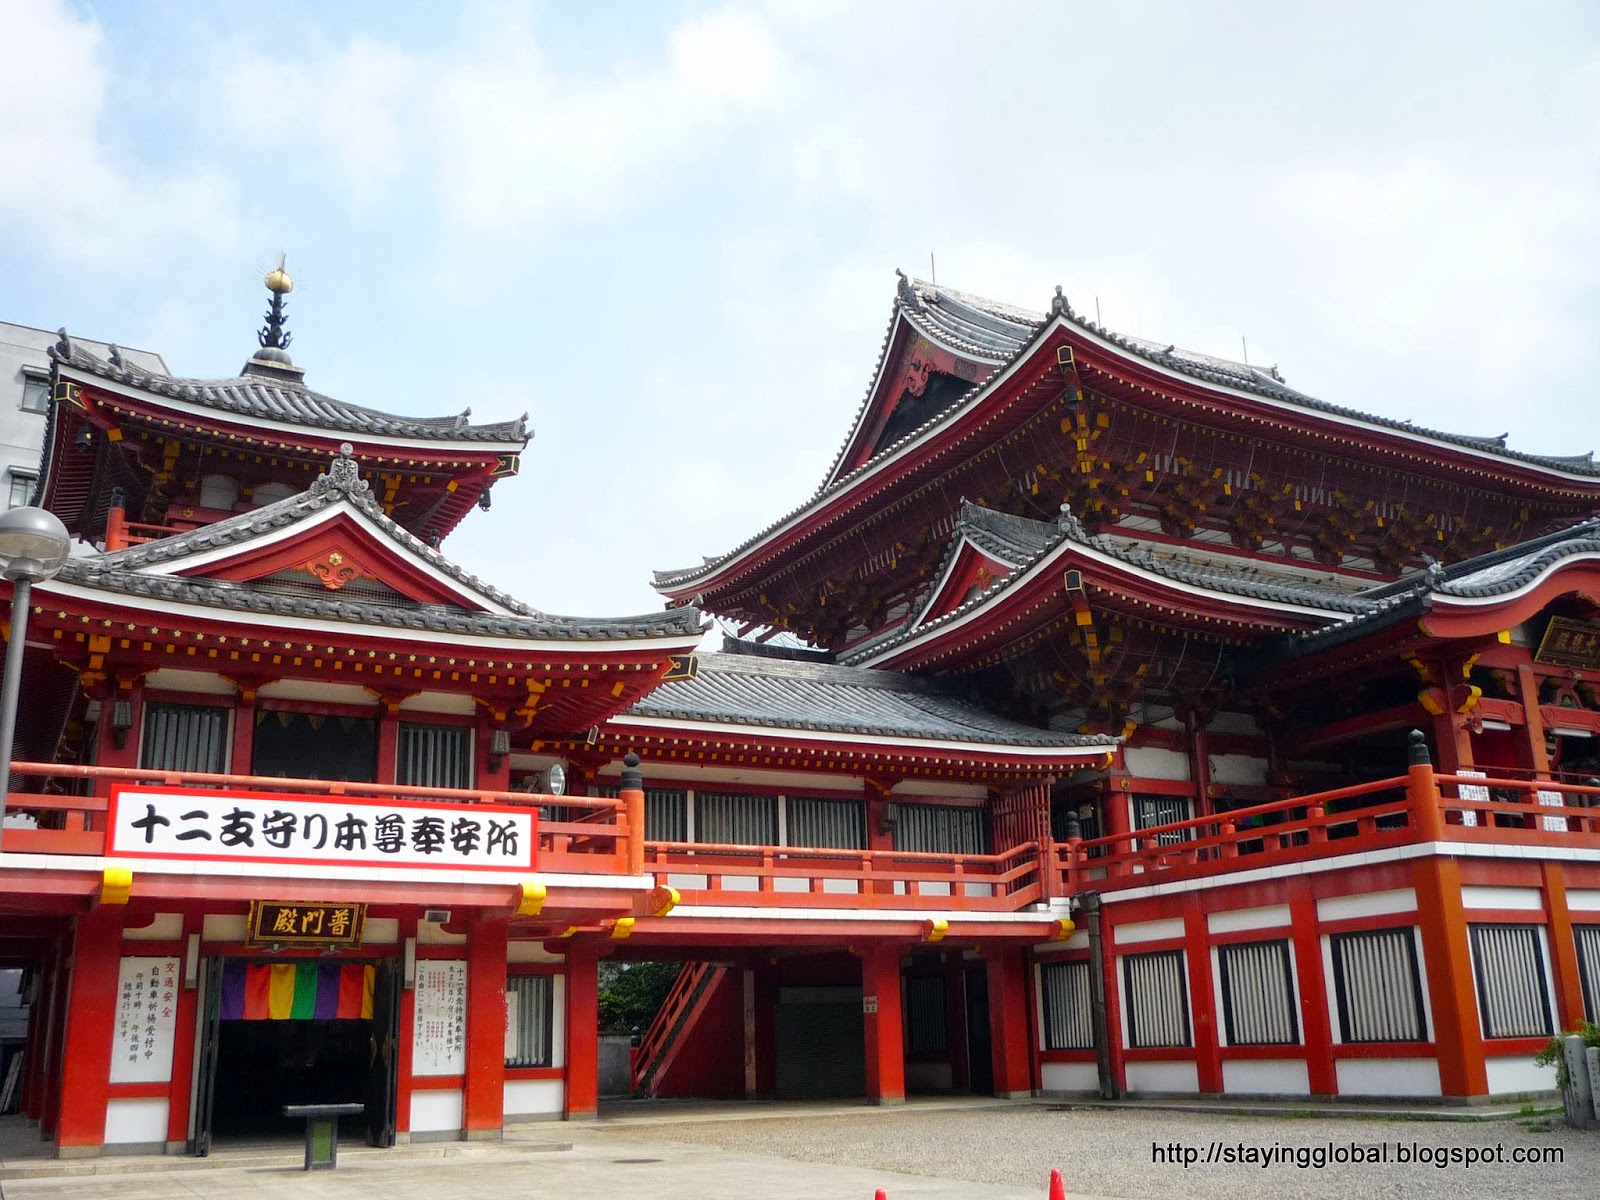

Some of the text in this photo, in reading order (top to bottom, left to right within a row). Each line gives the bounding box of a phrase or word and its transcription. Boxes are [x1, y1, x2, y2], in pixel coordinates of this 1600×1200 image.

[131, 804, 519, 856] 十二支守り本尊奉安所
[162, 962, 175, 1018] 交通安全
